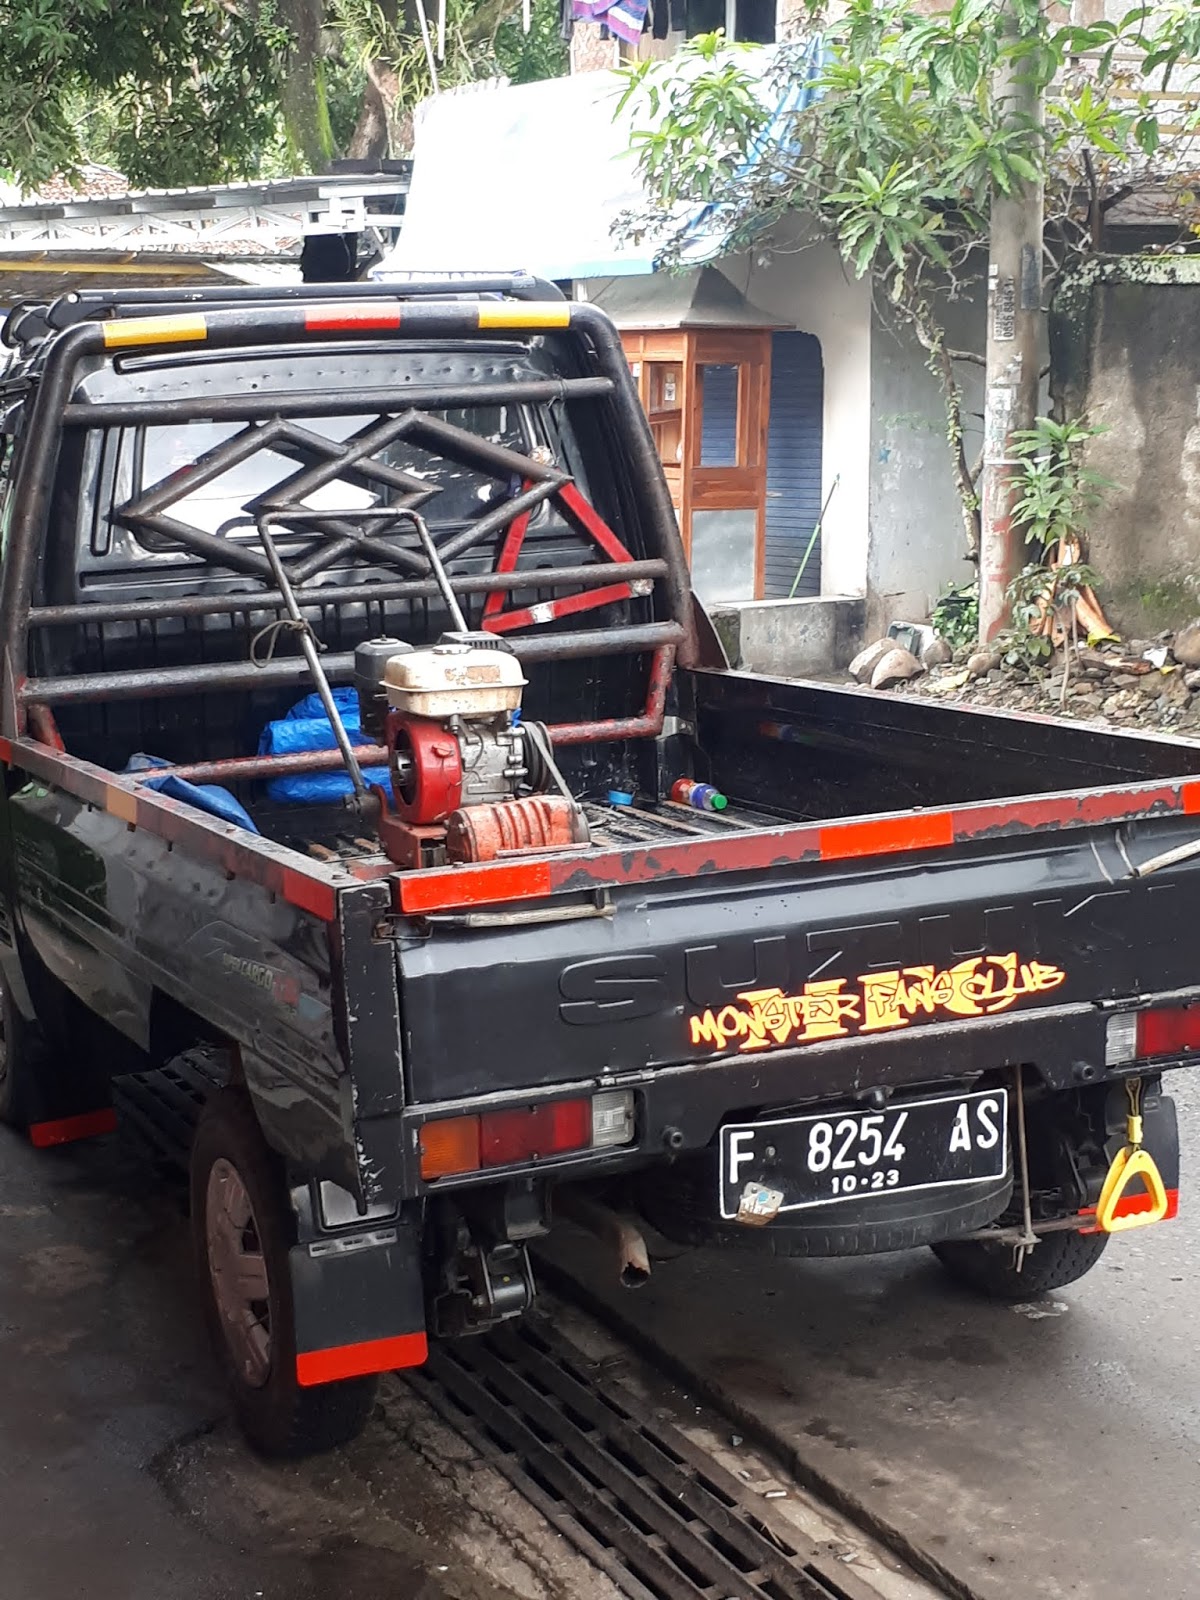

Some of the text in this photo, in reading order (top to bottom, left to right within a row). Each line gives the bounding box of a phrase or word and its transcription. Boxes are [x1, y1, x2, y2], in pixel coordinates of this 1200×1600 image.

[689, 960, 1065, 1049] MONSTER FANS CLUB
[729, 1098, 999, 1184] F 8254 AS
